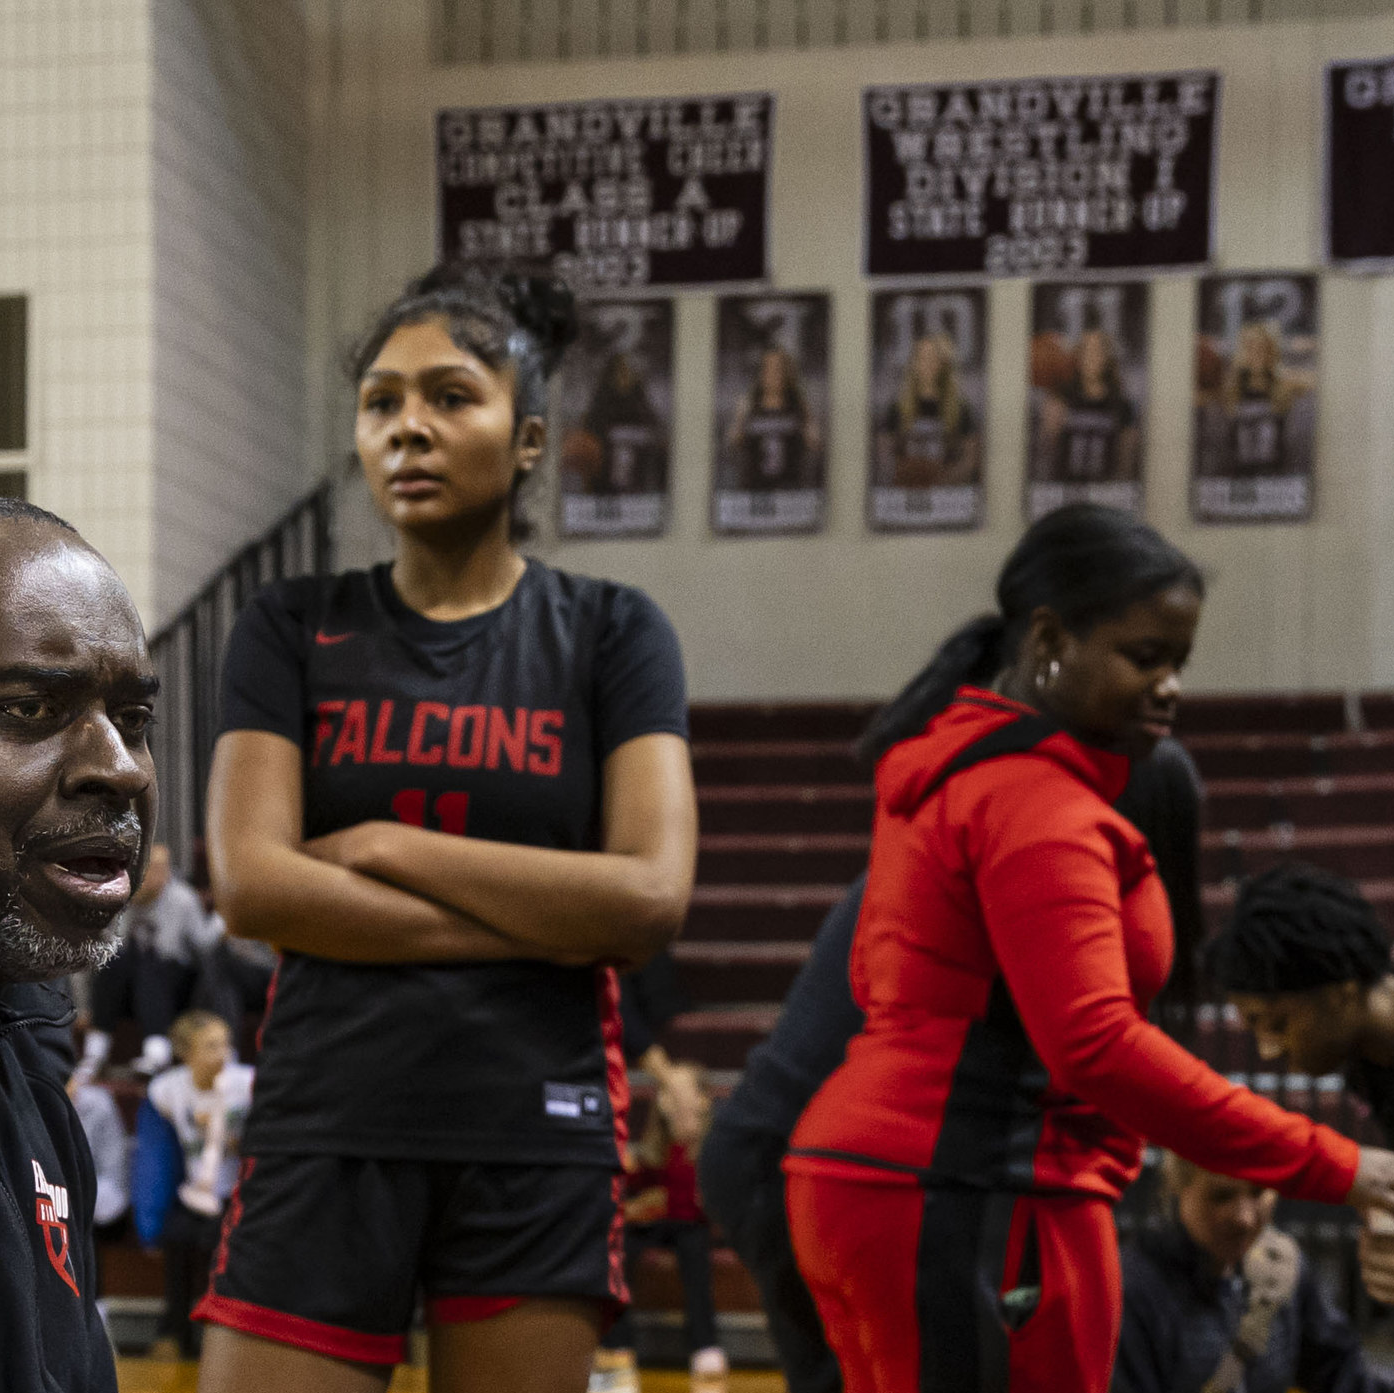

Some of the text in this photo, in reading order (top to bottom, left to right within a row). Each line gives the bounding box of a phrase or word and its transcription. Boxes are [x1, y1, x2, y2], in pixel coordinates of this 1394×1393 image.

[441, 102, 764, 147] GRANDVILLE
[869, 80, 1210, 129] GRANDVILLE
[891, 118, 1189, 165] WRESTLING
[493, 177, 654, 223] CLASS
[906, 157, 1132, 205] DIVISION
[887, 199, 986, 242] STATE
[312, 699, 566, 777] FALCONS
